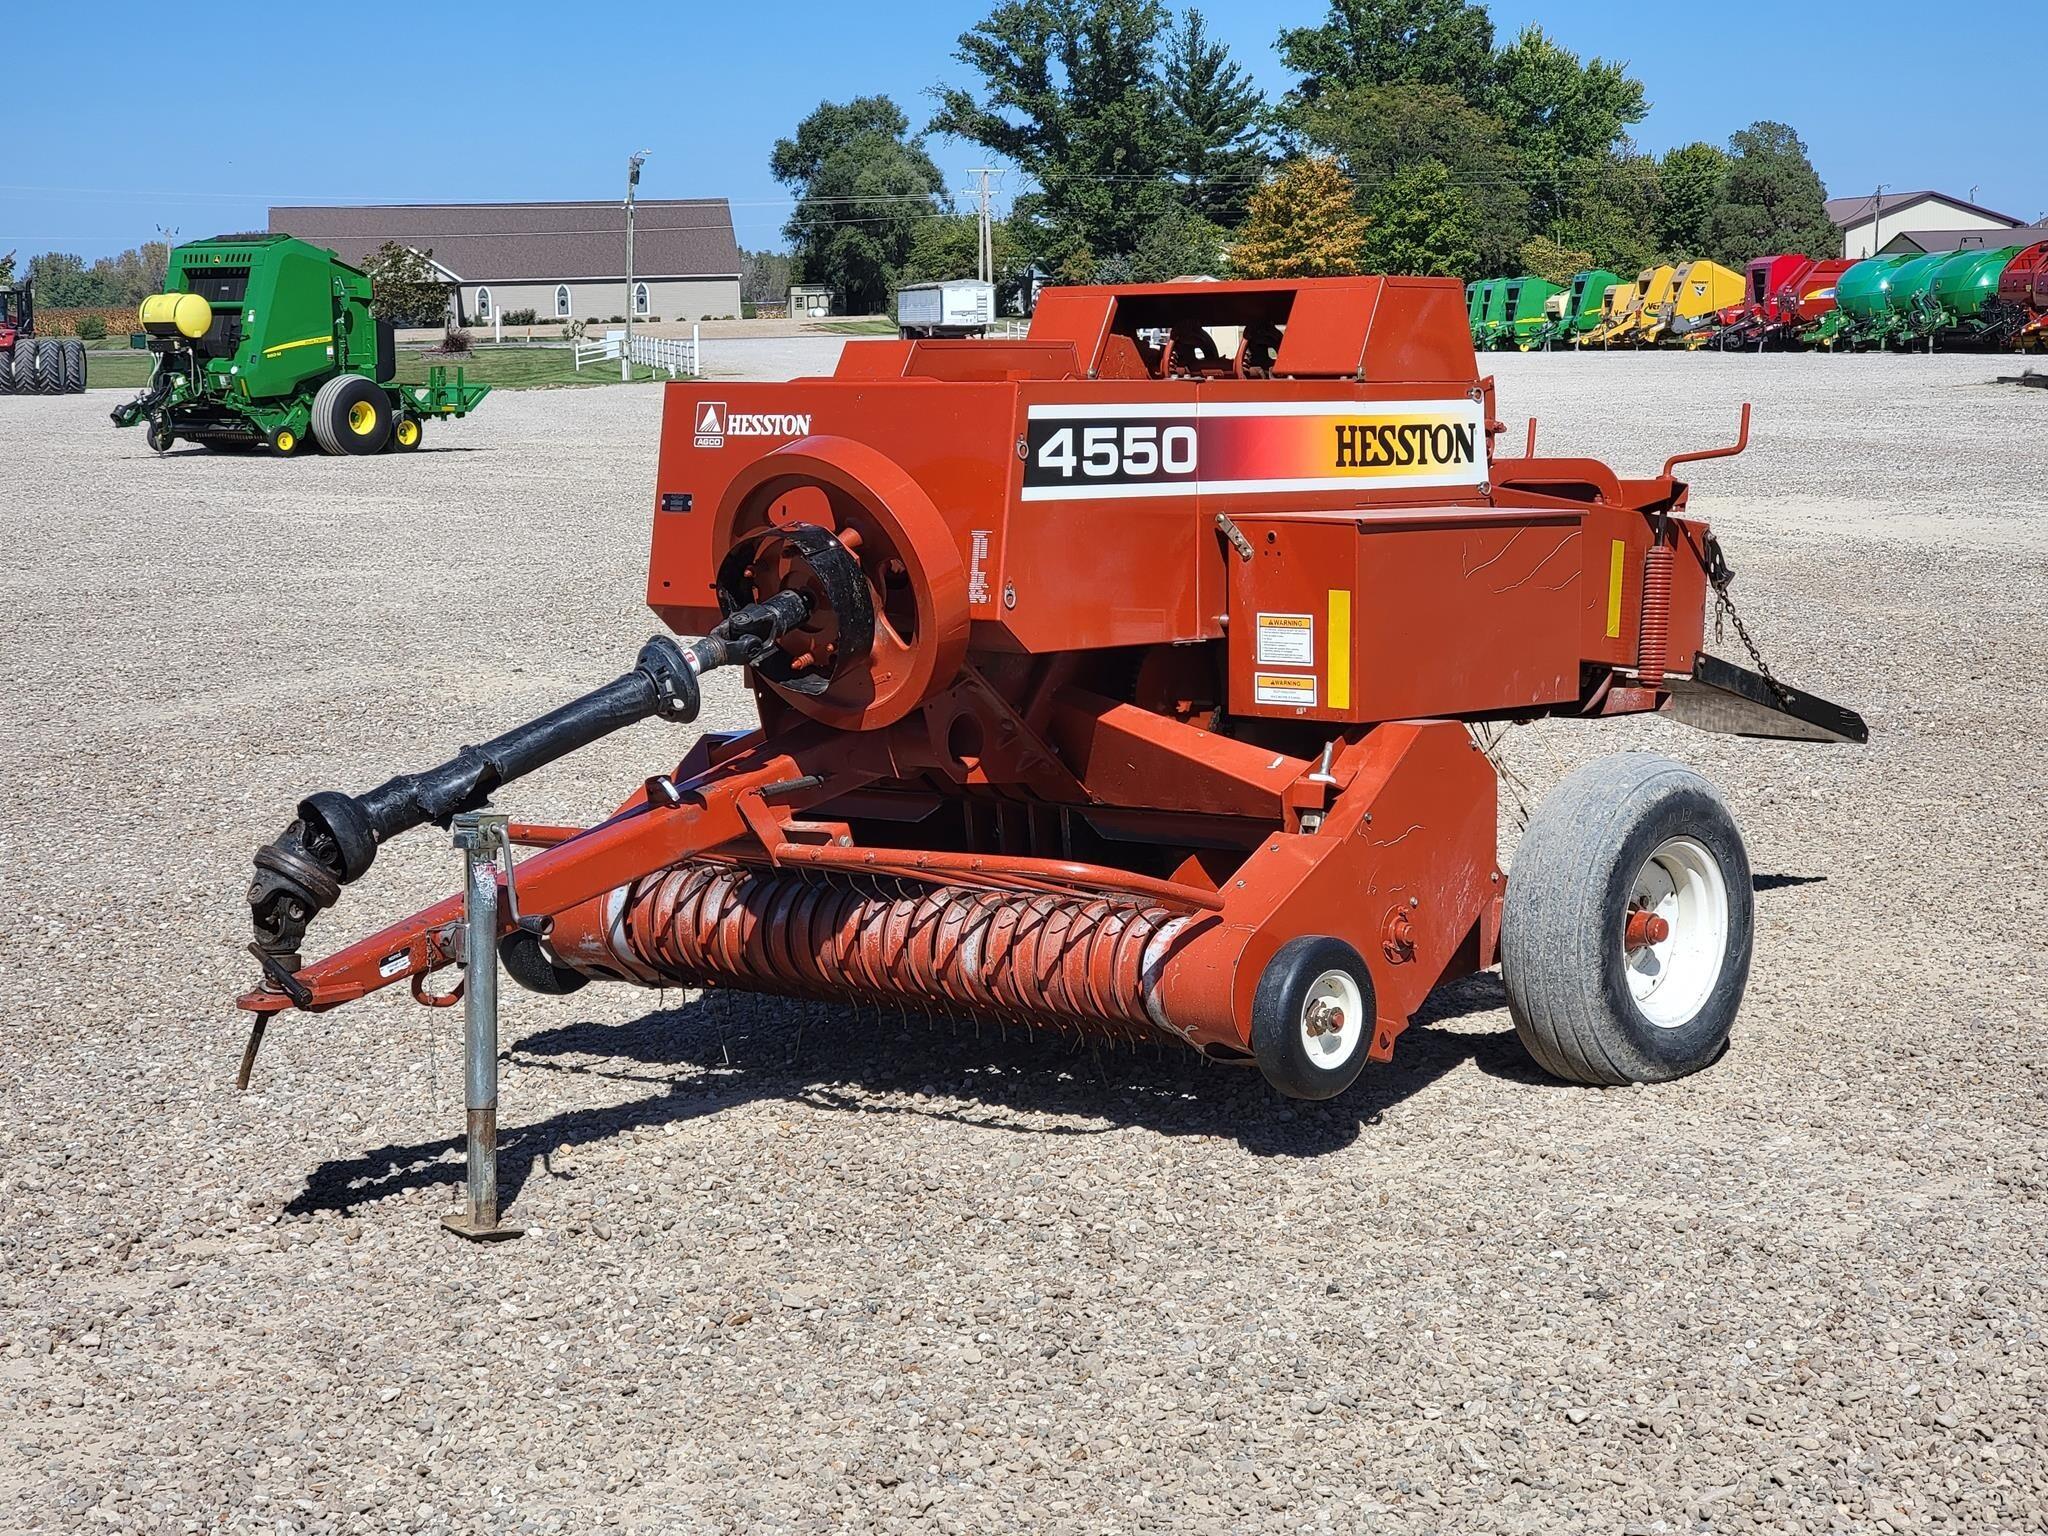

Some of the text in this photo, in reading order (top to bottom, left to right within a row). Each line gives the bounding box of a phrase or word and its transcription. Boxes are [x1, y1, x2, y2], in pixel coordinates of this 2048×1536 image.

[727, 414, 811, 436] HESSTON
[1038, 423, 1476, 477] 4550 HESSTON
[1273, 619, 1303, 627] WARNING
